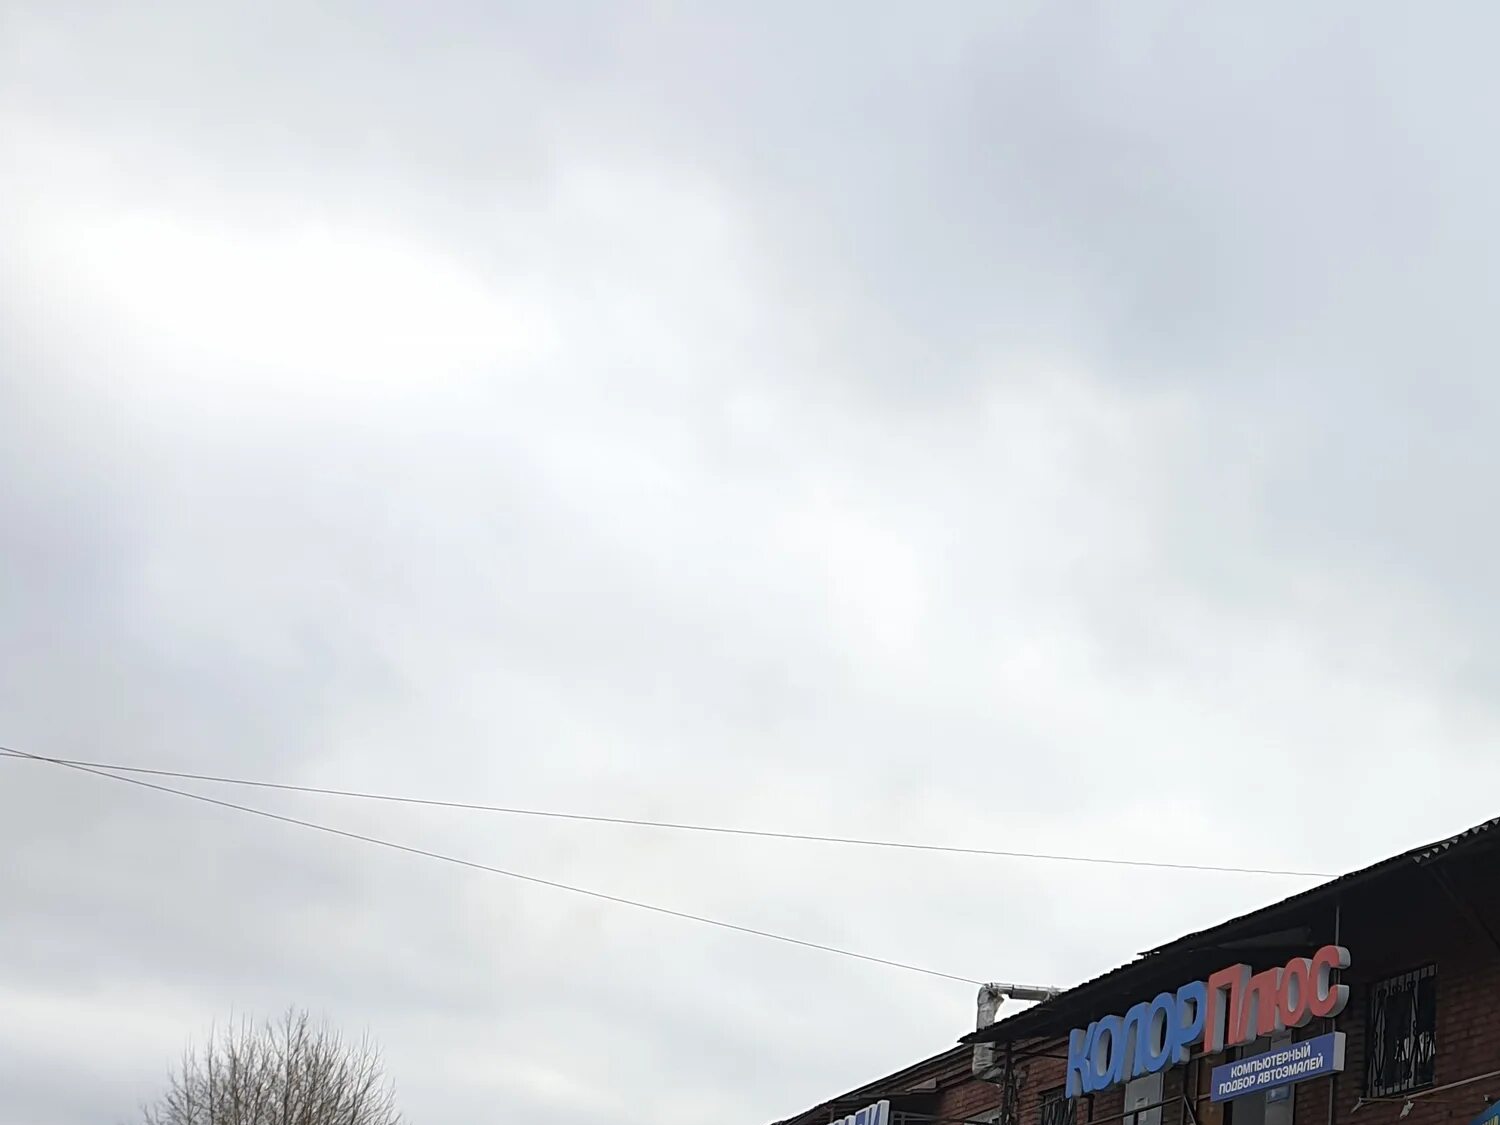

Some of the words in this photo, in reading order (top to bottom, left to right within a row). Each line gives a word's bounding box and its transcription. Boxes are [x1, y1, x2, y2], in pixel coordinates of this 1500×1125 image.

[1219, 1073, 1256, 1095] ПОДБОР
[1257, 1052, 1324, 1085] АВТОЭМАЛЕЙ
[1230, 1042, 1312, 1078] КОМПЬЮТЕРНЫЙ
